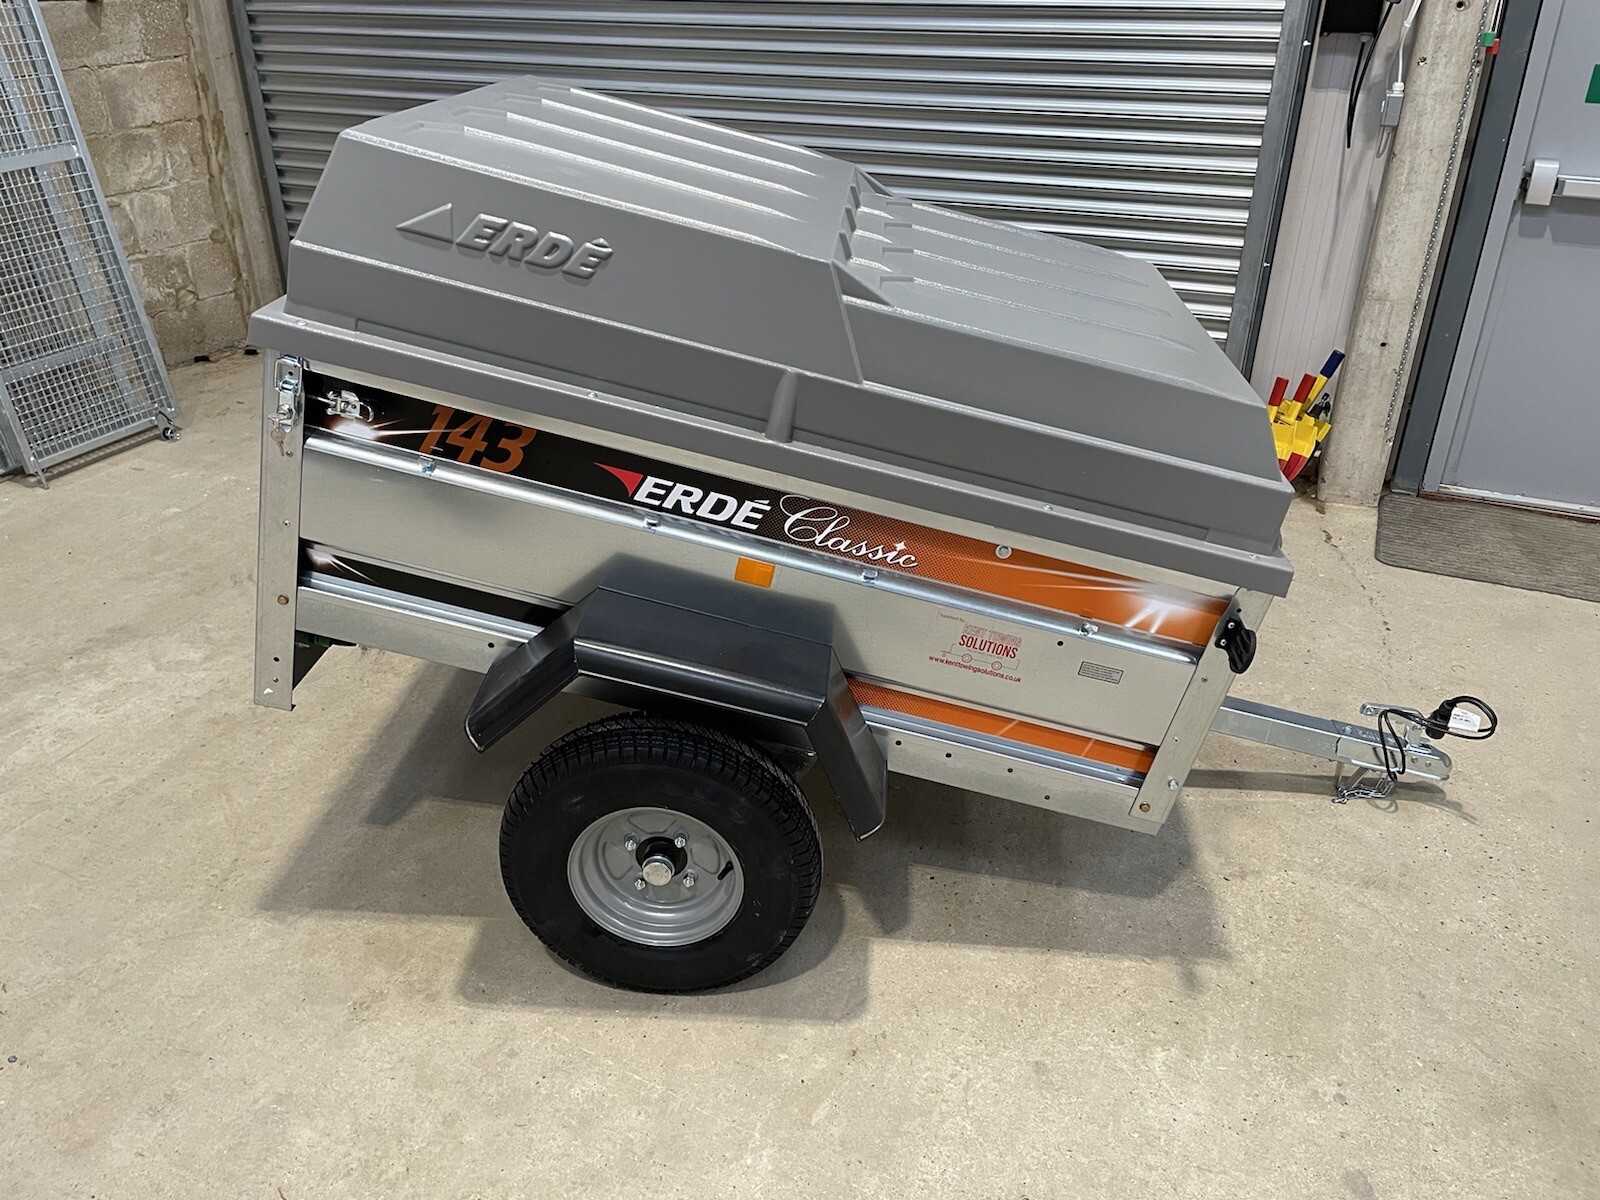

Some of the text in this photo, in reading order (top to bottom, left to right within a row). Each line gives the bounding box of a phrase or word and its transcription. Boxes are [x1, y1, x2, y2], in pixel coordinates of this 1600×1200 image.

[420, 404, 537, 473] 143
[633, 475, 917, 569] ERDÉ Classic
[928, 655, 1021, 683] www.kenttowingsolutions.co.uk
[959, 634, 1018, 659] SOLUTIONS
